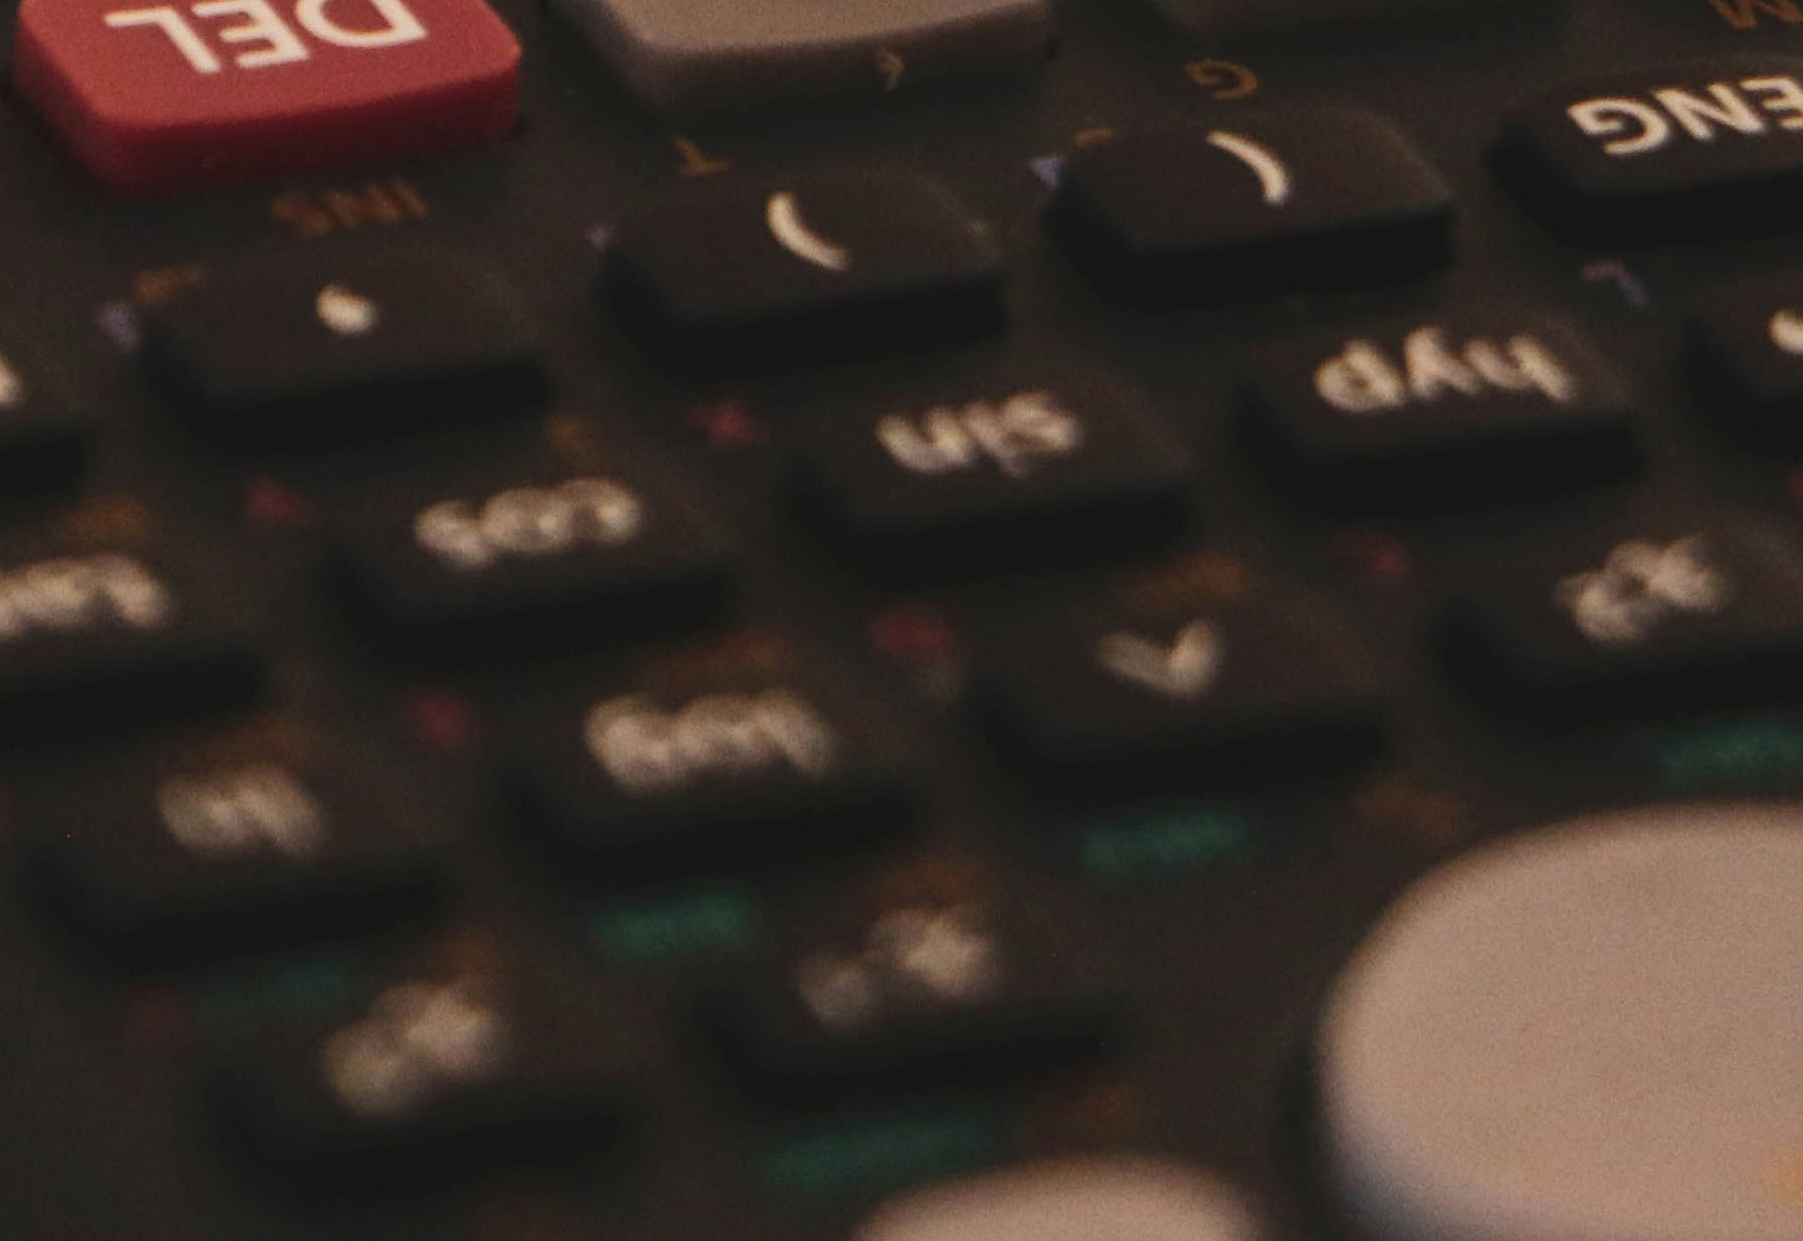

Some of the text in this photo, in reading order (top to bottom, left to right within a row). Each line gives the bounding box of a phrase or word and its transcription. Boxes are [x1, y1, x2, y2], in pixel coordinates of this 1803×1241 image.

[1183, 61, 1258, 99] G
[1567, 76, 1803, 157] ENG
[1313, 325, 1578, 414] hyp
[874, 391, 1082, 475] sin
